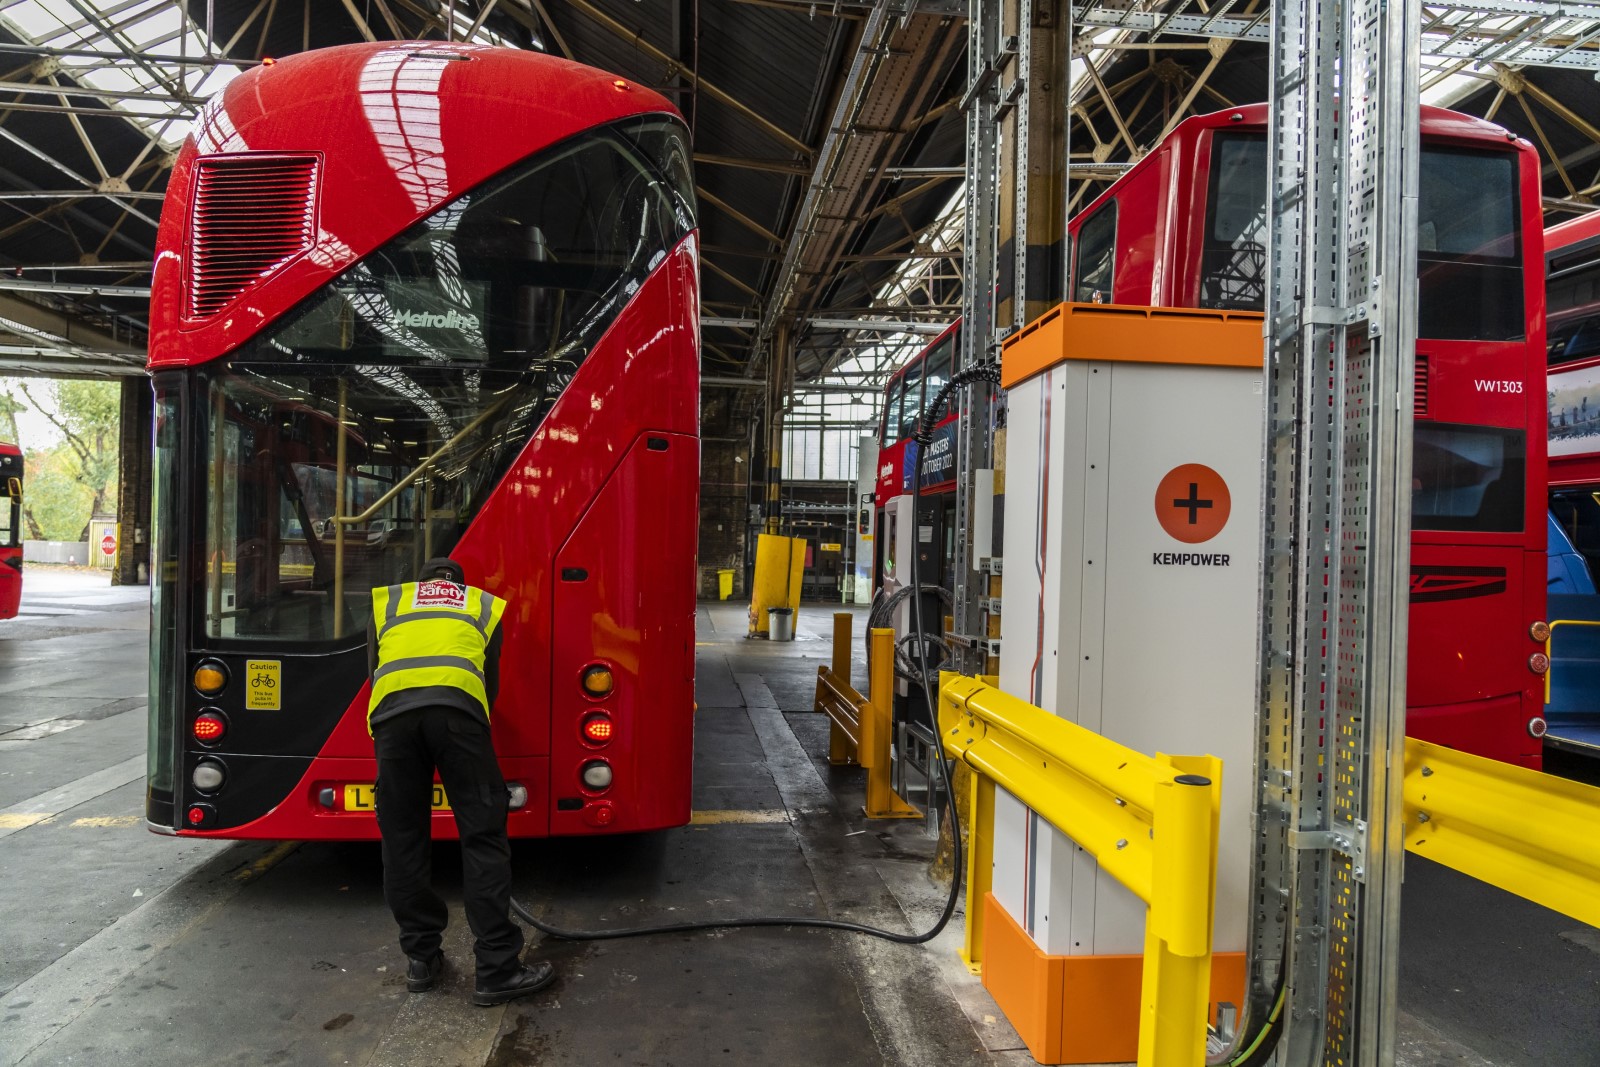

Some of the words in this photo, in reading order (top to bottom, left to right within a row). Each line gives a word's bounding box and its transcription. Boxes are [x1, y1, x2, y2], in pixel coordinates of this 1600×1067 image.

[394, 308, 480, 329] Metroline
[1474, 379, 1523, 393] VW1303
[930, 437, 949, 456] MASTERS
[1153, 552, 1230, 566] KEMPOWER
[416, 599, 464, 607] Metroline
